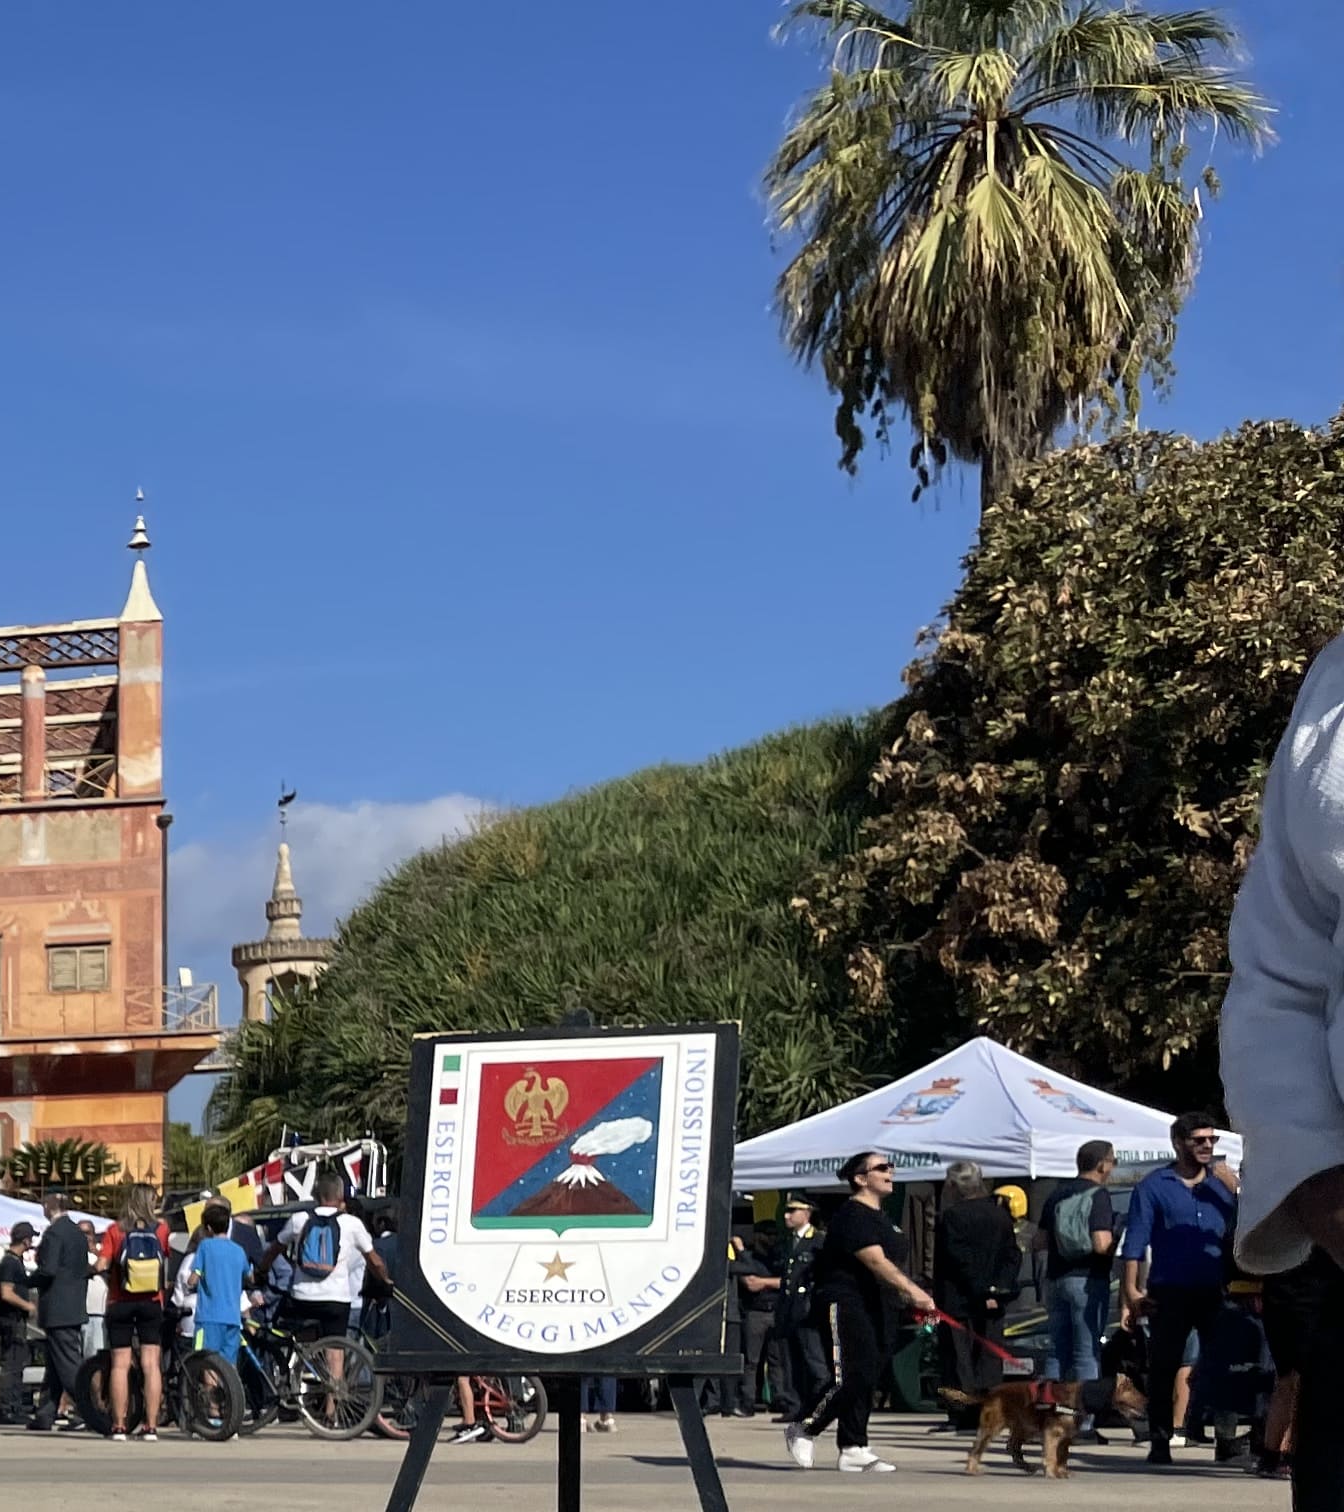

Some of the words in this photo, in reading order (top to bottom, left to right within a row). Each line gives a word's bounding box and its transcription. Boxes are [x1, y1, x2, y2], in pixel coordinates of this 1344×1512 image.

[428, 1120, 456, 1244] ESERCITO
[675, 1047, 708, 1232] TRASMISSIONI
[476, 1264, 682, 1343] REGGIMENTO
[504, 1288, 606, 1304] ESERCITO
